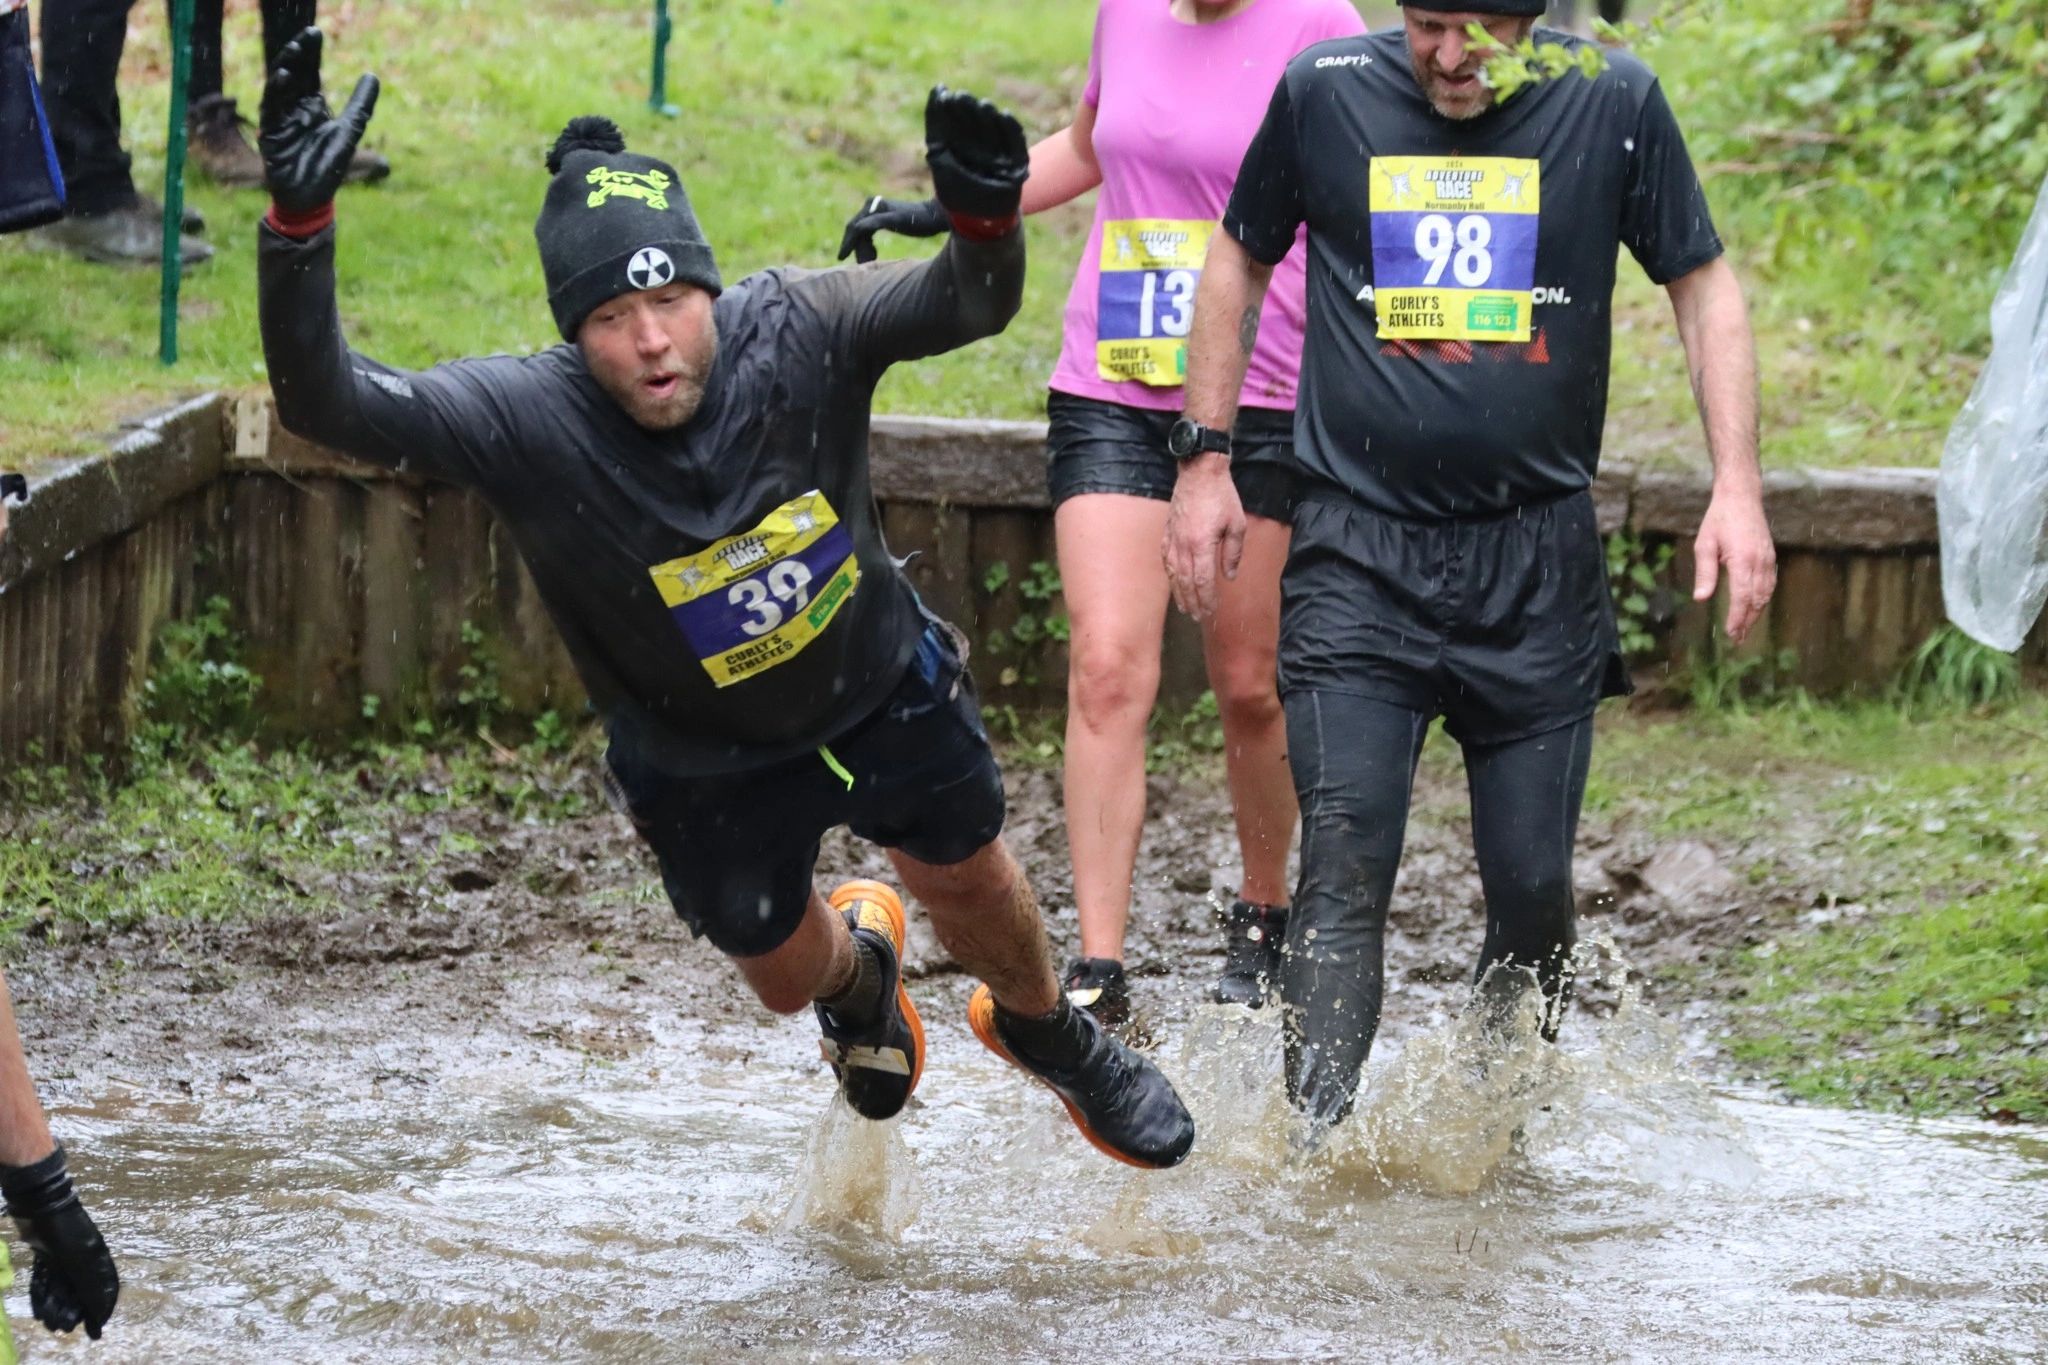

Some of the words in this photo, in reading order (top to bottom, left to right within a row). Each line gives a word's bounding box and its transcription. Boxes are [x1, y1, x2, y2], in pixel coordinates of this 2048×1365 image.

[1315, 55, 1360, 68] CRAFT
[1424, 169, 1485, 182] ADVENTURE
[1435, 180, 1473, 199] RACE
[1425, 201, 1467, 211] Normanby
[1414, 214, 1493, 287] 98
[1391, 296, 1440, 310] CURLY'S
[1388, 312, 1445, 328] ATHLETES
[725, 540, 771, 571] RACE
[727, 560, 813, 636] 39
[724, 633, 782, 666] CURLY'S
[727, 640, 794, 677] ATHLETES
